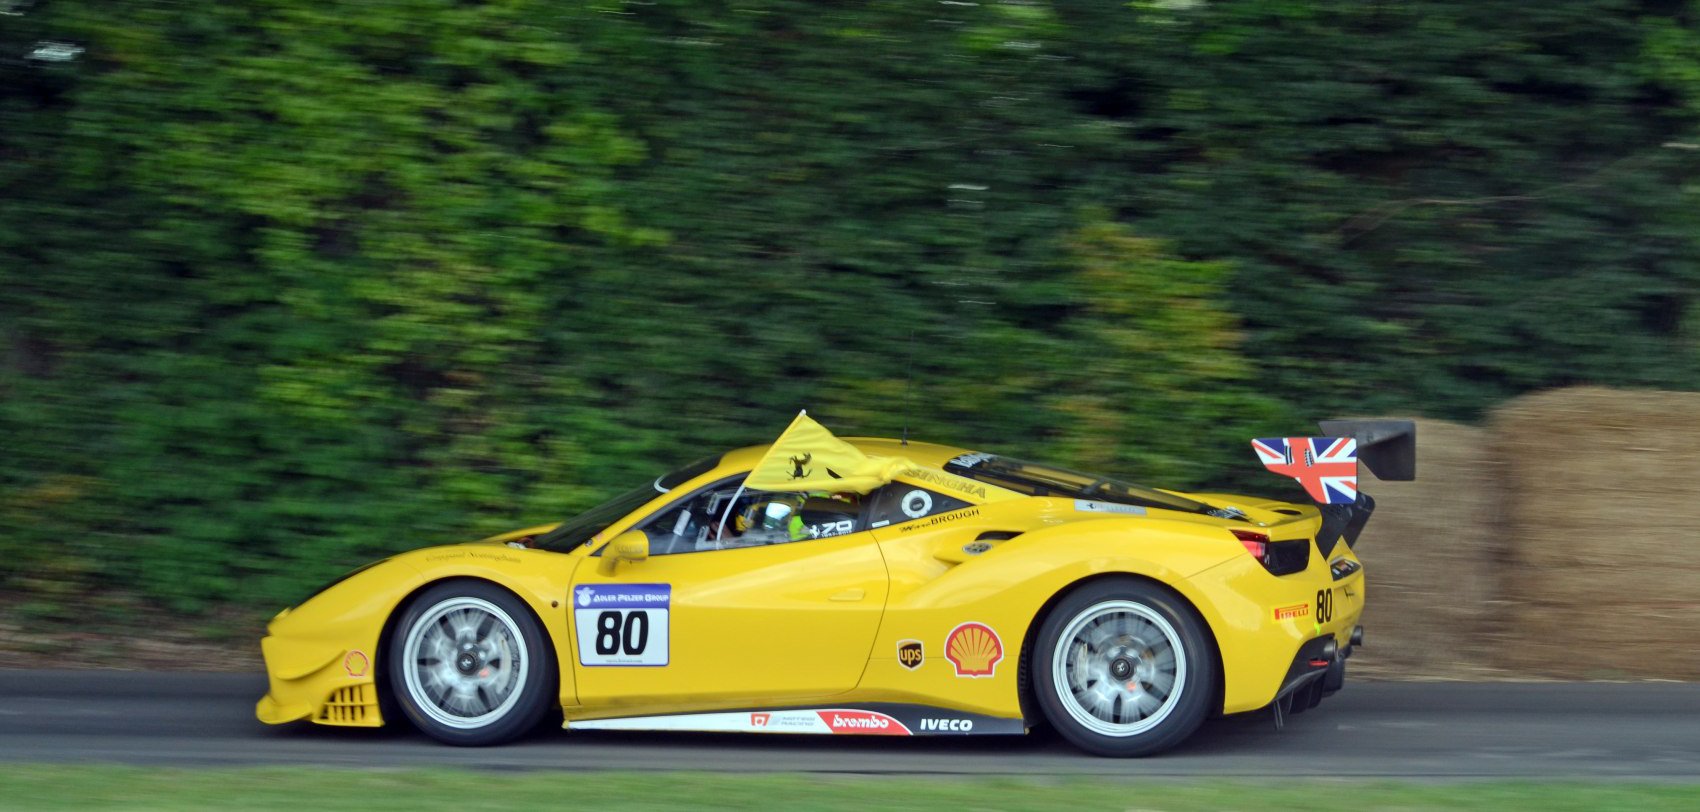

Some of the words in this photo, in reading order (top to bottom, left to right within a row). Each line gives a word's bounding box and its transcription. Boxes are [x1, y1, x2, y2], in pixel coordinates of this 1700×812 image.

[930, 509, 980, 525] BROUGH
[821, 520, 852, 534] 70
[1275, 604, 1309, 620] PIRELLI
[1316, 588, 1332, 624] 80
[596, 610, 649, 655] 80
[900, 648, 922, 665] ups
[833, 714, 889, 729] brembo
[920, 718, 973, 731] IVECO
